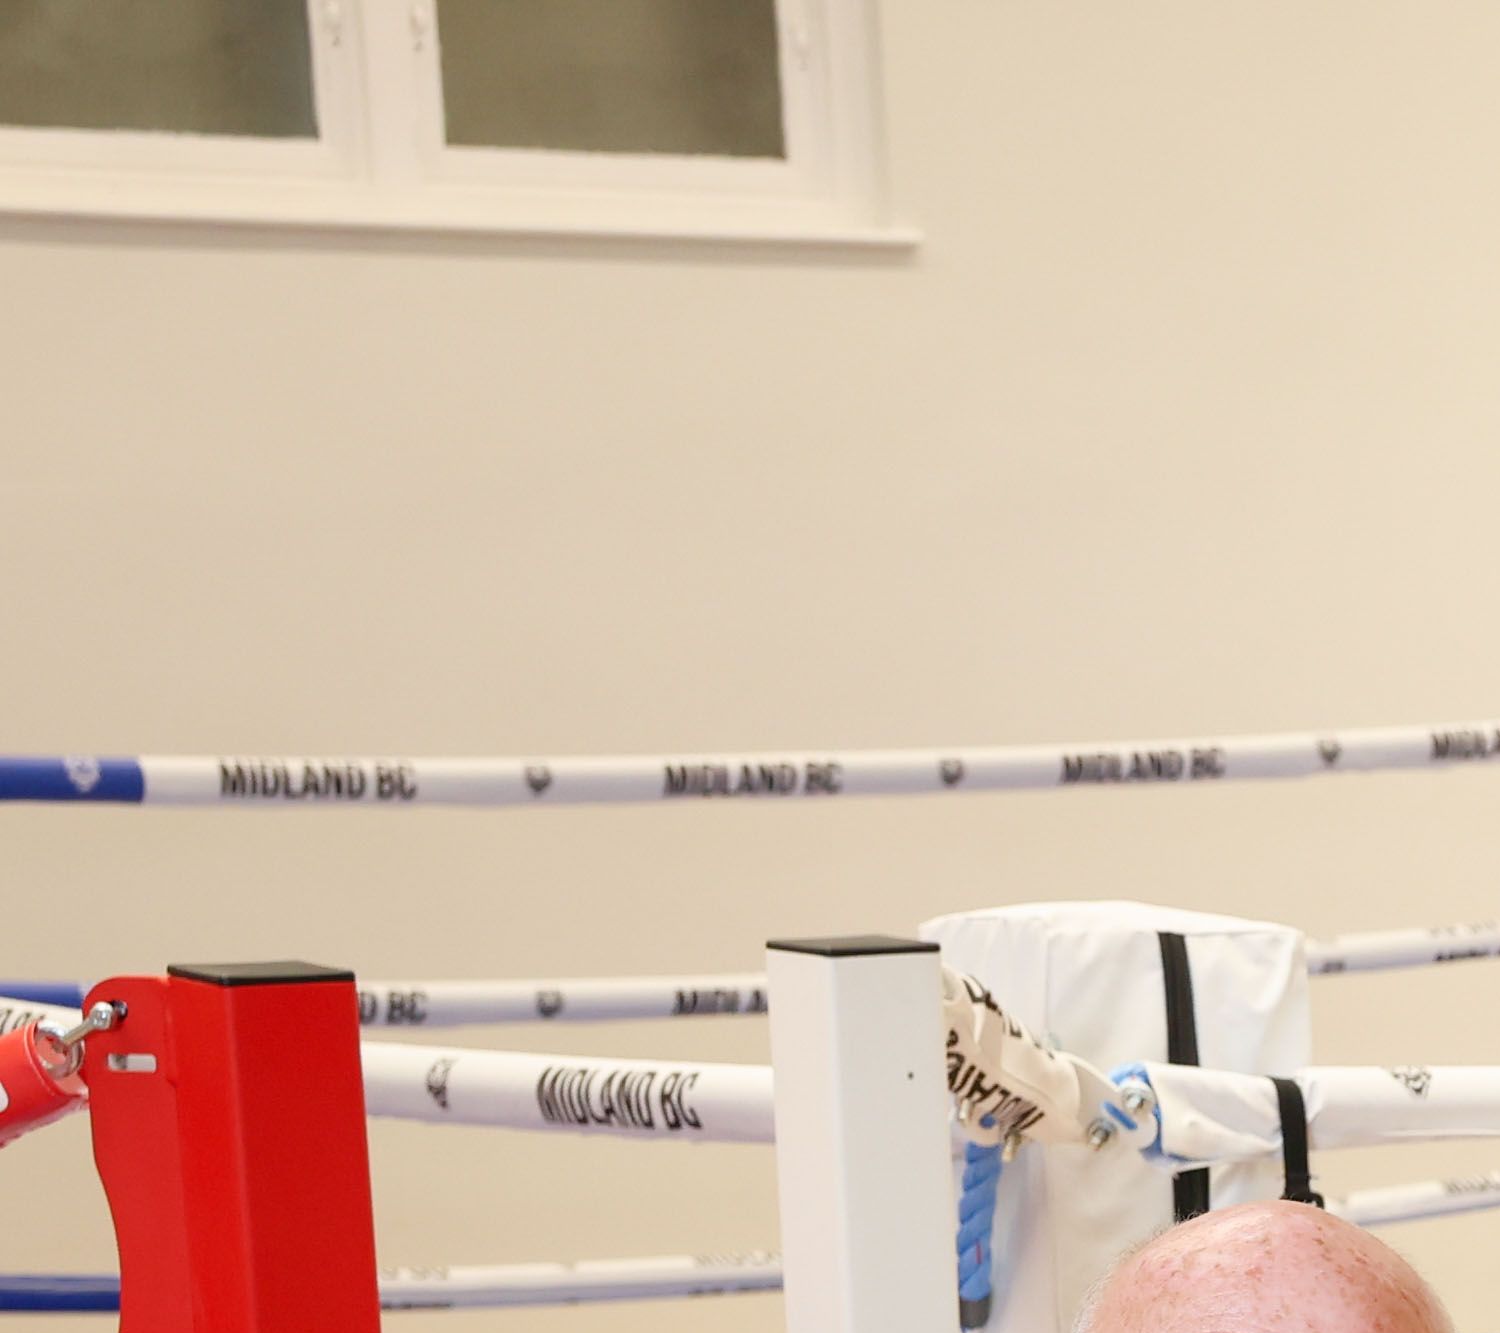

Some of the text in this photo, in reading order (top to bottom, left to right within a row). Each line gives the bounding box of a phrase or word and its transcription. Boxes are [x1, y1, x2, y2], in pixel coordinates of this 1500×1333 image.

[219, 762, 418, 801] MIDLAND BC
[662, 761, 844, 796] MIDLAND BC
[1060, 746, 1226, 785] MIDLAND BC
[386, 989, 428, 1024] BC
[537, 1066, 703, 1132] MIDLAND BC
